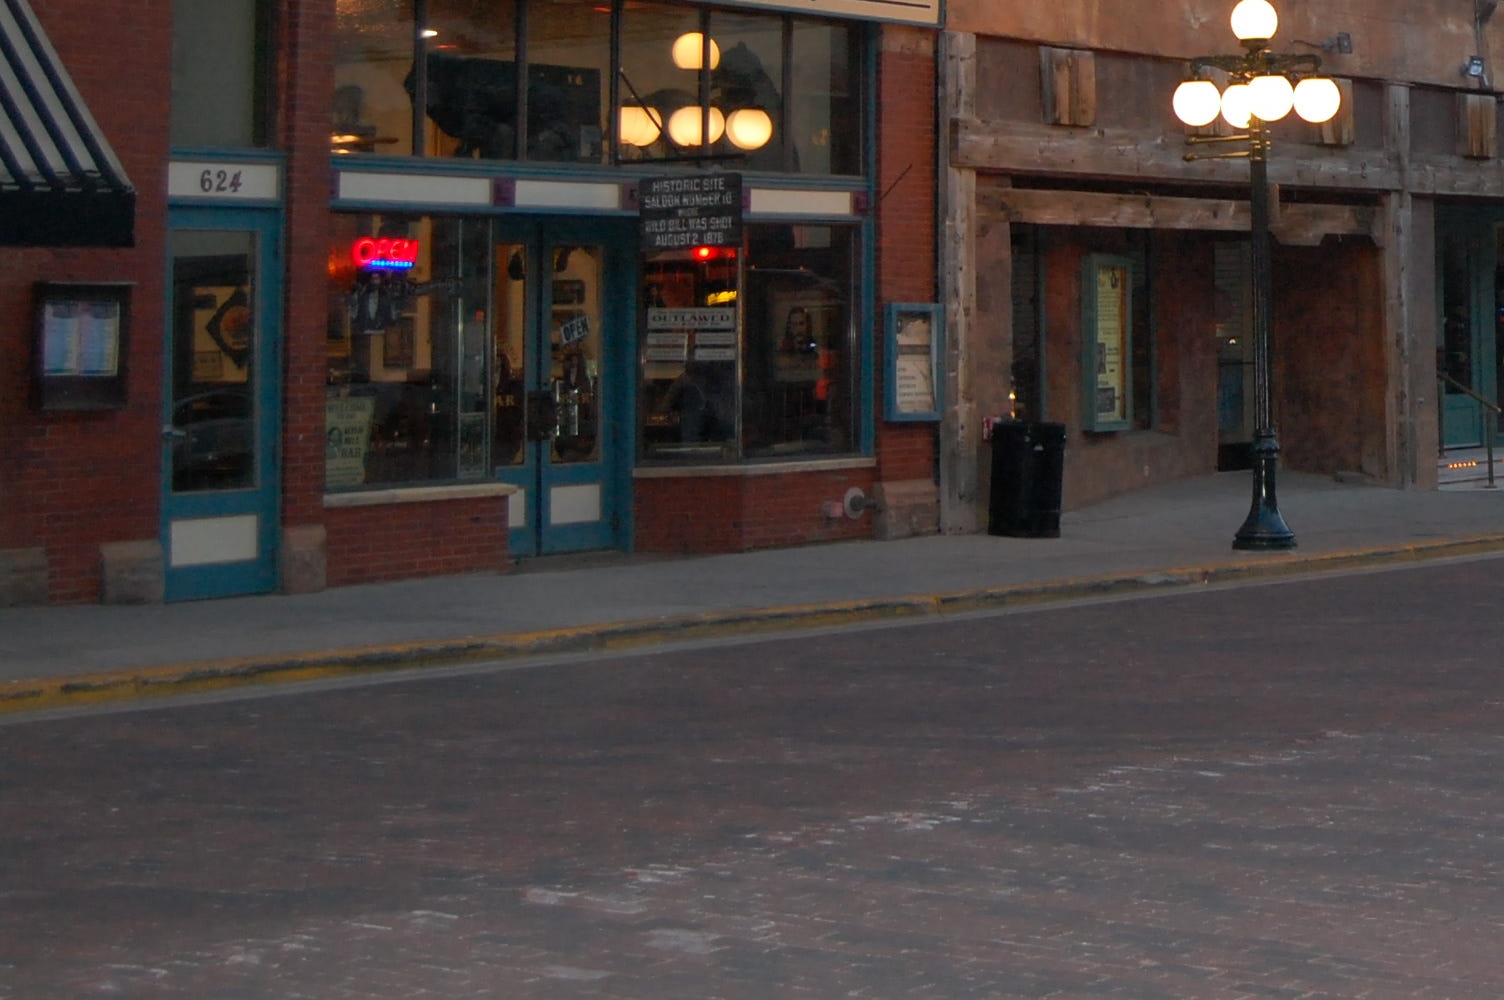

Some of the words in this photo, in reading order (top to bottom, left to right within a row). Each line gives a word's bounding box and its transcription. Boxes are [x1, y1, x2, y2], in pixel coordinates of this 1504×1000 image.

[199, 169, 243, 193] 624
[652, 180, 700, 193] HISTORIC
[703, 177, 726, 191] SITE
[644, 194, 681, 209] SALOON
[682, 193, 720, 206] NUMBER
[721, 191, 733, 205] 10
[644, 219, 667, 233] WILD
[668, 218, 687, 232] BILL
[688, 217, 708, 231] WAS
[709, 216, 733, 230] SHOT
[655, 233, 690, 247] AUGUST
[351, 236, 420, 268] OPEN
[652, 314, 730, 323] OUTLAWED
[562, 317, 590, 342] OPEN
